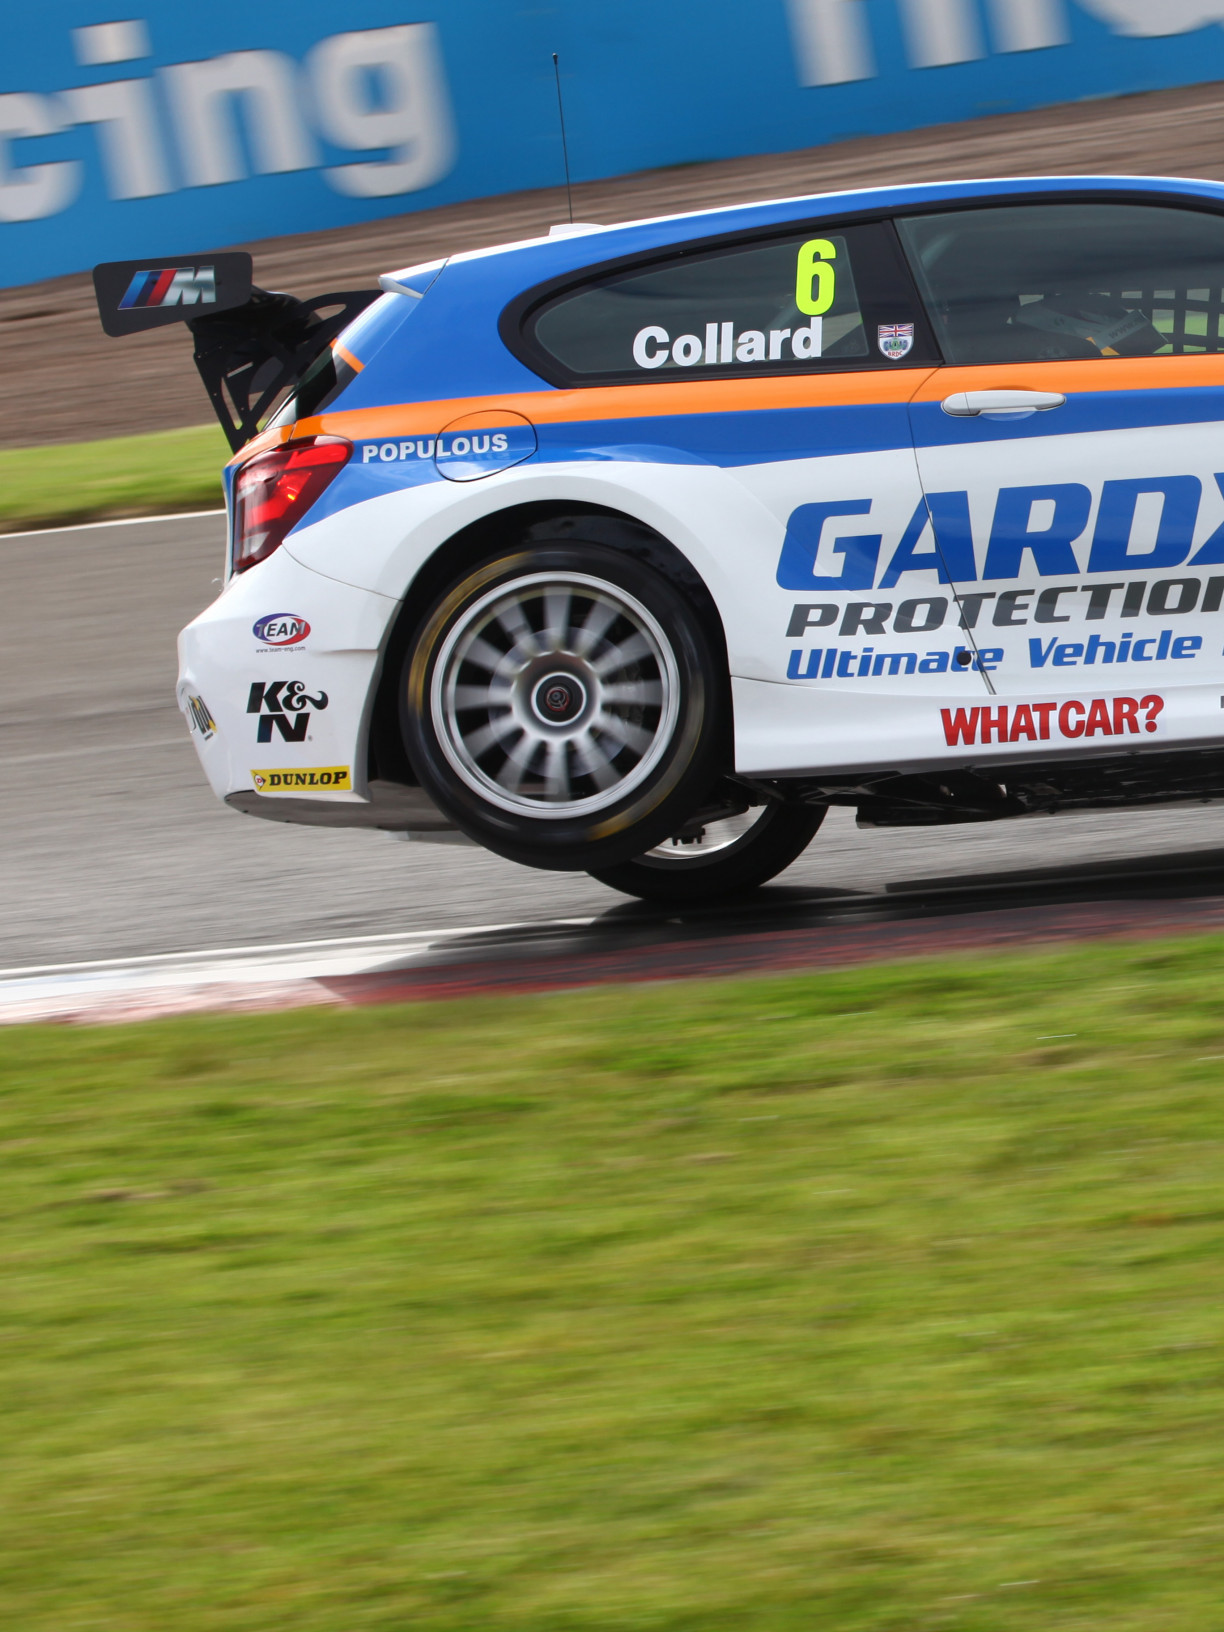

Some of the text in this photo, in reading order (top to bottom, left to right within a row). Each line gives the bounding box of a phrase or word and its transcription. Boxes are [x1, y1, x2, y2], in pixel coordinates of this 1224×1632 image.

[796, 239, 836, 316] 6
[632, 316, 822, 369] Collard
[362, 433, 508, 464] POPULOUS
[256, 621, 307, 638] TEAM
[786, 646, 1004, 680] Ultimate
[1028, 630, 1202, 668] Vehicle
[268, 771, 348, 787] DUNLOP
